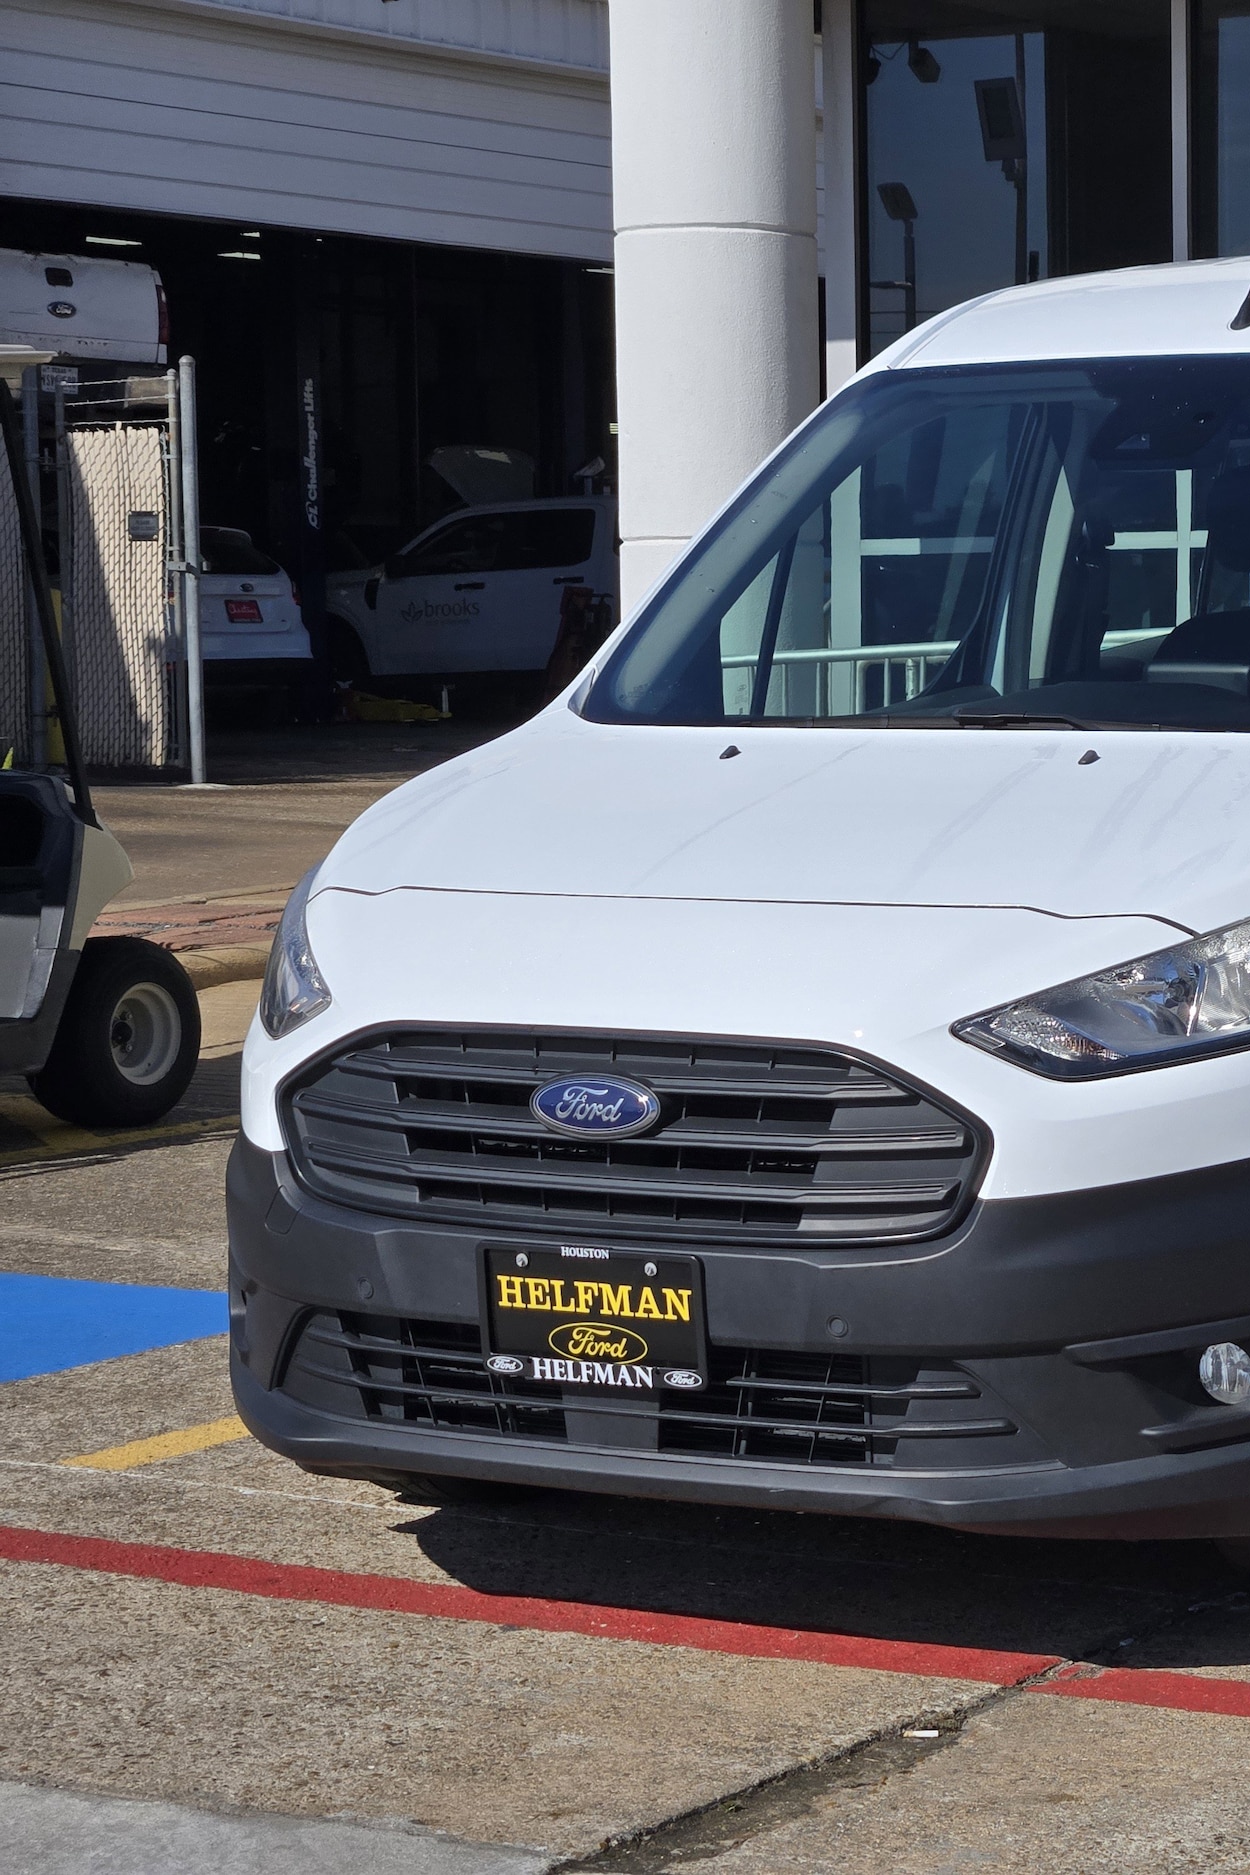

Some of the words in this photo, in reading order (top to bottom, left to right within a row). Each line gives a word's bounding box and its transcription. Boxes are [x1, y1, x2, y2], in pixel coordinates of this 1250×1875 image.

[304, 413, 318, 501] Challenger
[424, 597, 480, 617] brooks
[555, 1085, 625, 1123] Ford
[561, 1246, 610, 1260] HOUSTON
[497, 1274, 692, 1322] HELFMAN
[568, 1324, 628, 1359] Ford
[493, 1357, 517, 1371] Ford
[531, 1356, 653, 1388] HELFMAN
[670, 1371, 696, 1386] Ford
